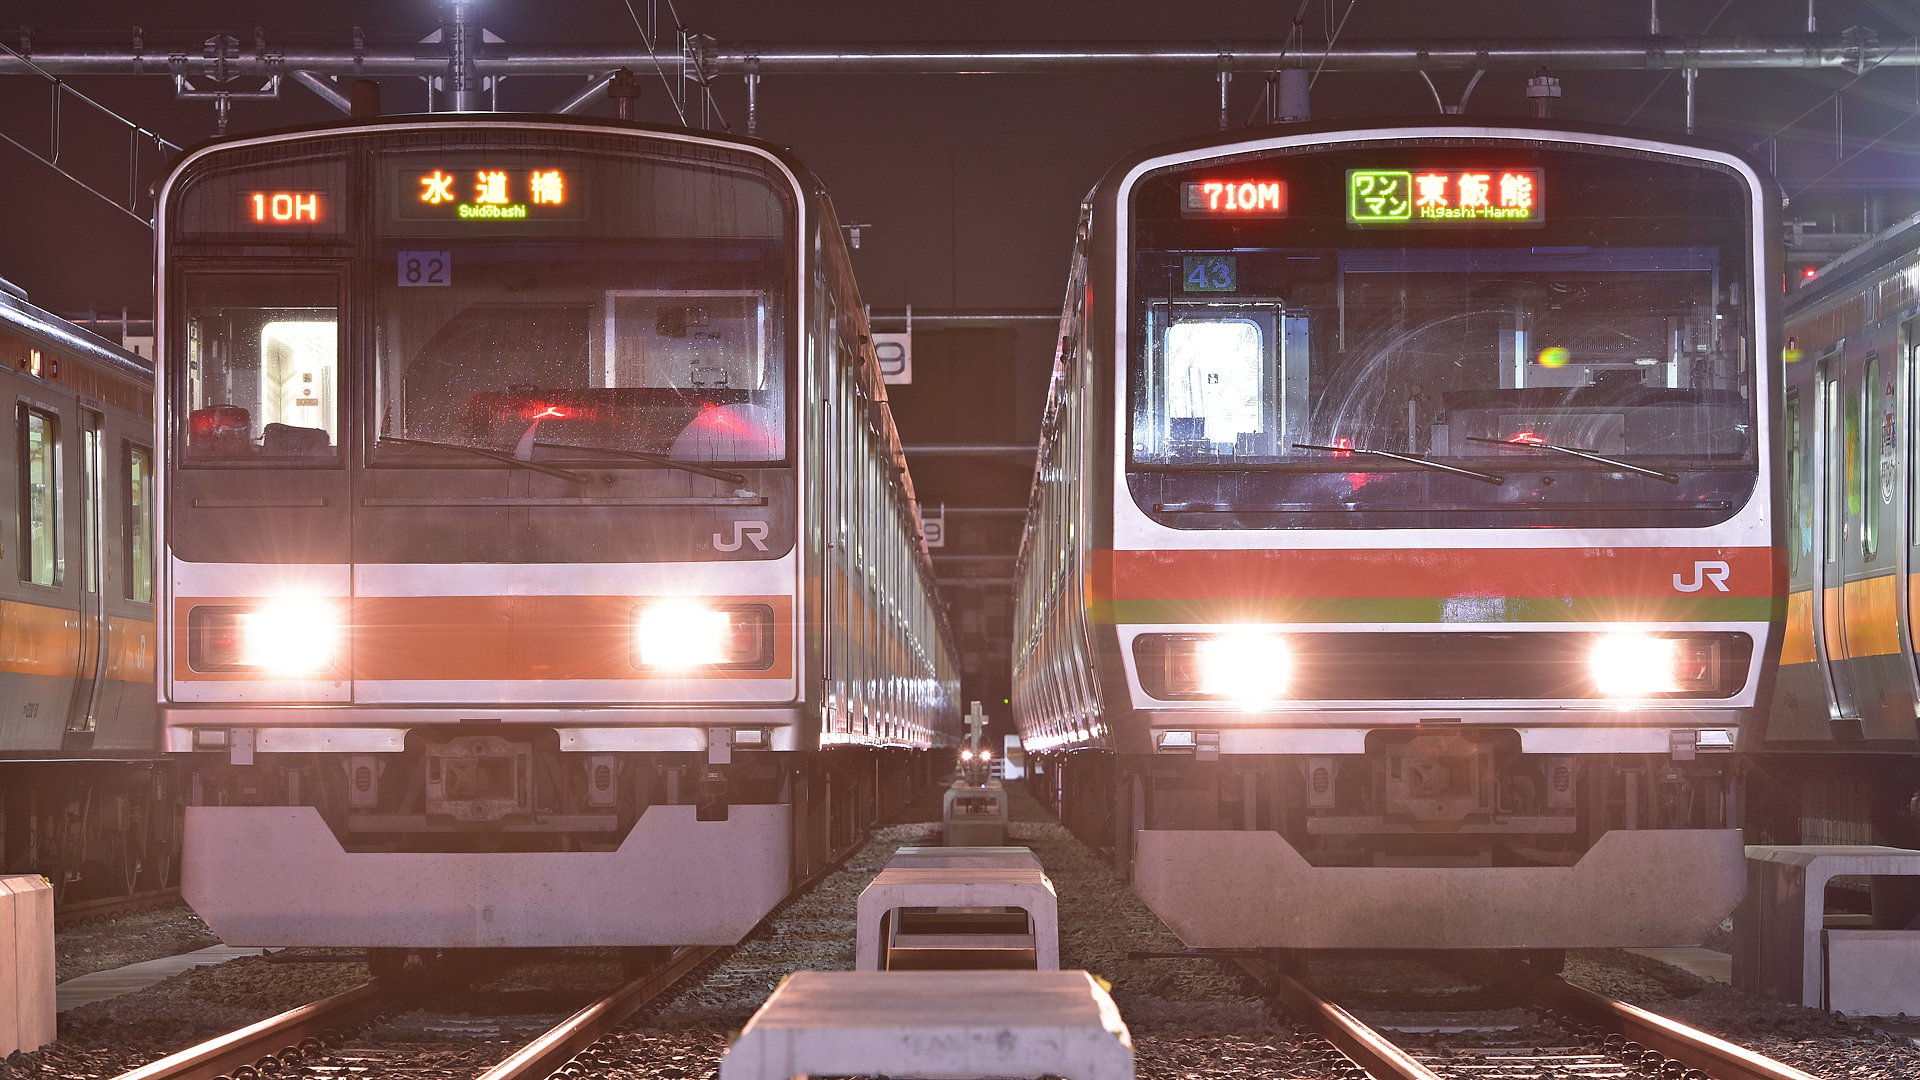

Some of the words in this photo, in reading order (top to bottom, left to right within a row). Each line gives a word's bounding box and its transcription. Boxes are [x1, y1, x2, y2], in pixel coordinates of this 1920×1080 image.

[421, 171, 564, 204] 水道橋
[1203, 183, 1280, 210] 710M
[1356, 176, 1398, 196] ワン
[1416, 173, 1533, 207] 東飯能
[253, 194, 317, 221] 10H
[458, 205, 526, 218] Suidōbashi
[1364, 197, 1408, 216] マン
[405, 258, 444, 284] 82
[1187, 263, 1232, 288] 43
[713, 521, 769, 551] JR
[1673, 561, 1730, 592] JR
